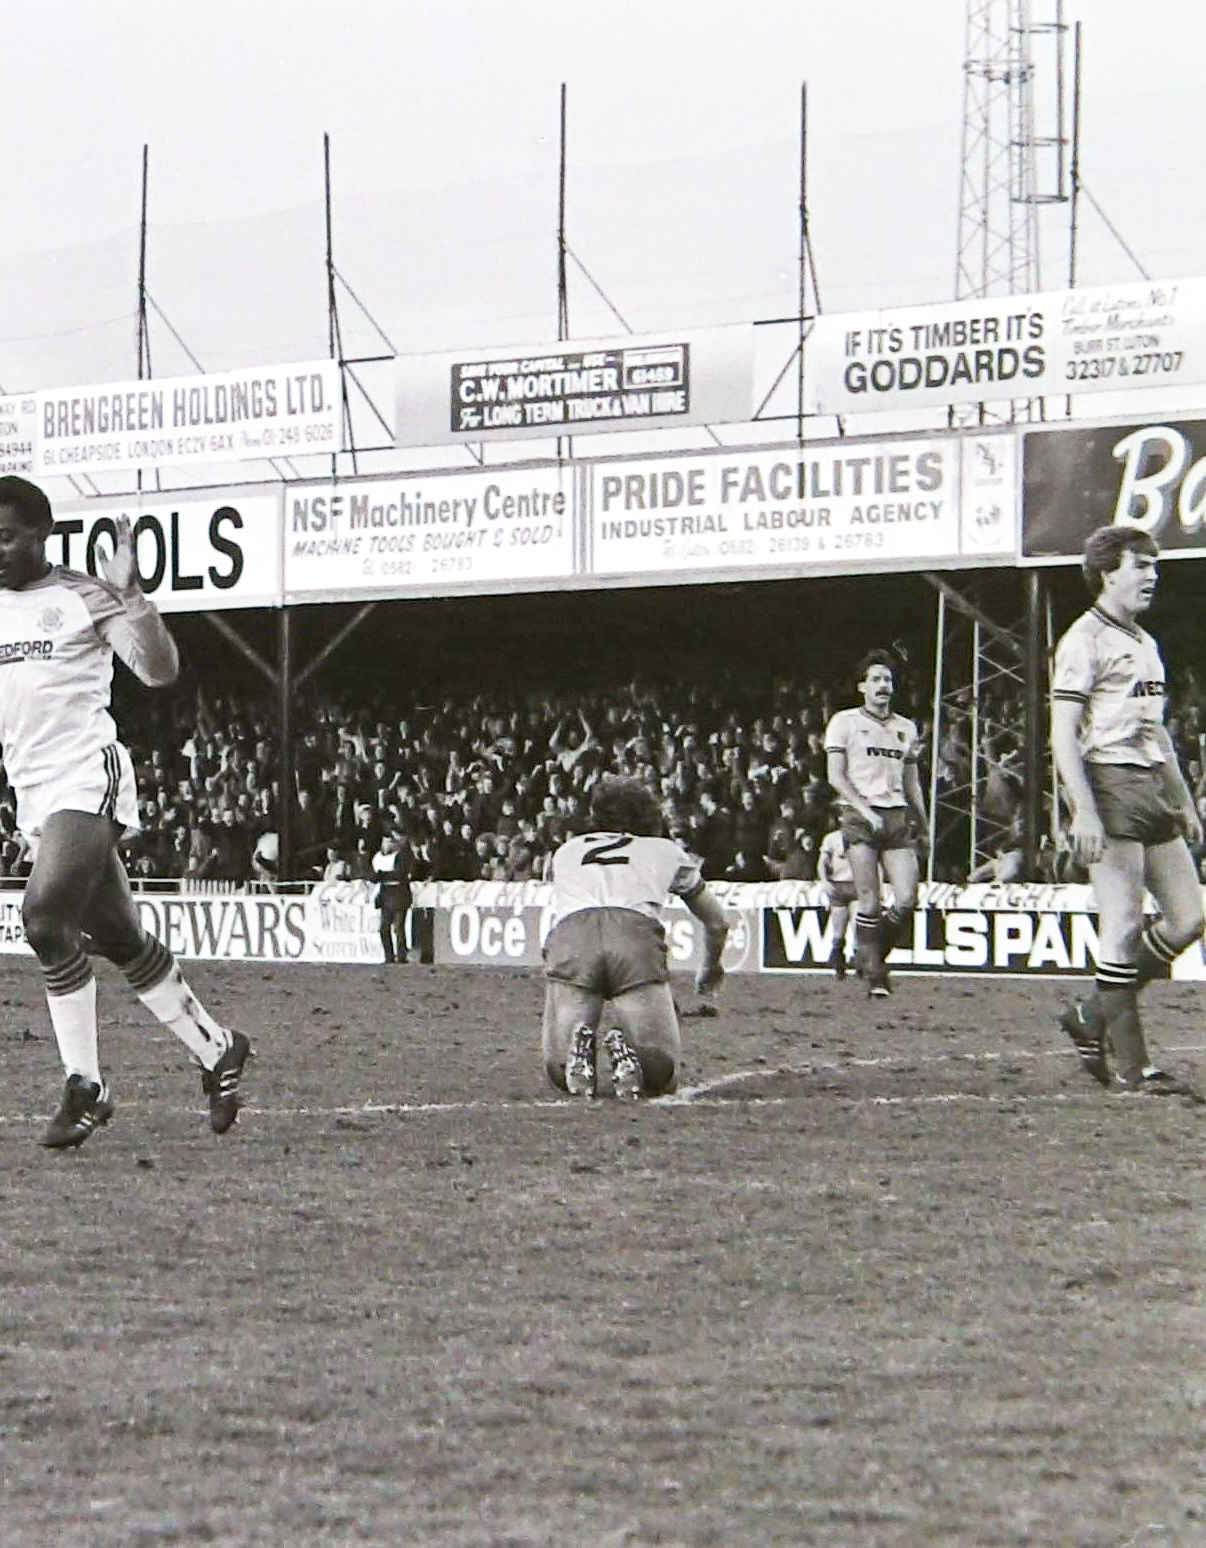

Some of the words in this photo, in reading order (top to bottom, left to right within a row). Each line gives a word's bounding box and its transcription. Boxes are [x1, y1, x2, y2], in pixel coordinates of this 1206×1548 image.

[845, 331, 862, 357] IF
[909, 317, 1000, 348] TIMBER
[844, 346, 1046, 394] GODDARDS
[1132, 351, 1184, 375] 27707
[43, 390, 164, 438] BRENGREEN
[173, 378, 277, 427] HOLDINGS
[286, 374, 333, 416] LTD.
[483, 404, 522, 426] LONG
[525, 400, 564, 423] TERM
[128, 438, 173, 458] LONDON
[601, 469, 705, 511] PRIDE
[721, 450, 944, 505] FACILITIES
[293, 495, 343, 532] NSF
[350, 491, 477, 529] Machinery
[483, 484, 566, 520] Centre
[601, 514, 729, 540] INDUSTRIAL
[743, 509, 831, 532] LABOUR
[850, 500, 944, 526] AGENCY
[51, 506, 244, 594] TOOLS
[292, 537, 364, 557] MACHINE
[370, 534, 415, 553] TOOLS
[423, 529, 488, 552] BOUGHT
[510, 525, 554, 545] SOLD
[1132, 681, 1166, 697] IVEC
[580, 835, 634, 866] 2
[136, 896, 306, 958] DEWAR'S
[777, 908, 1100, 969] WLSPAN
